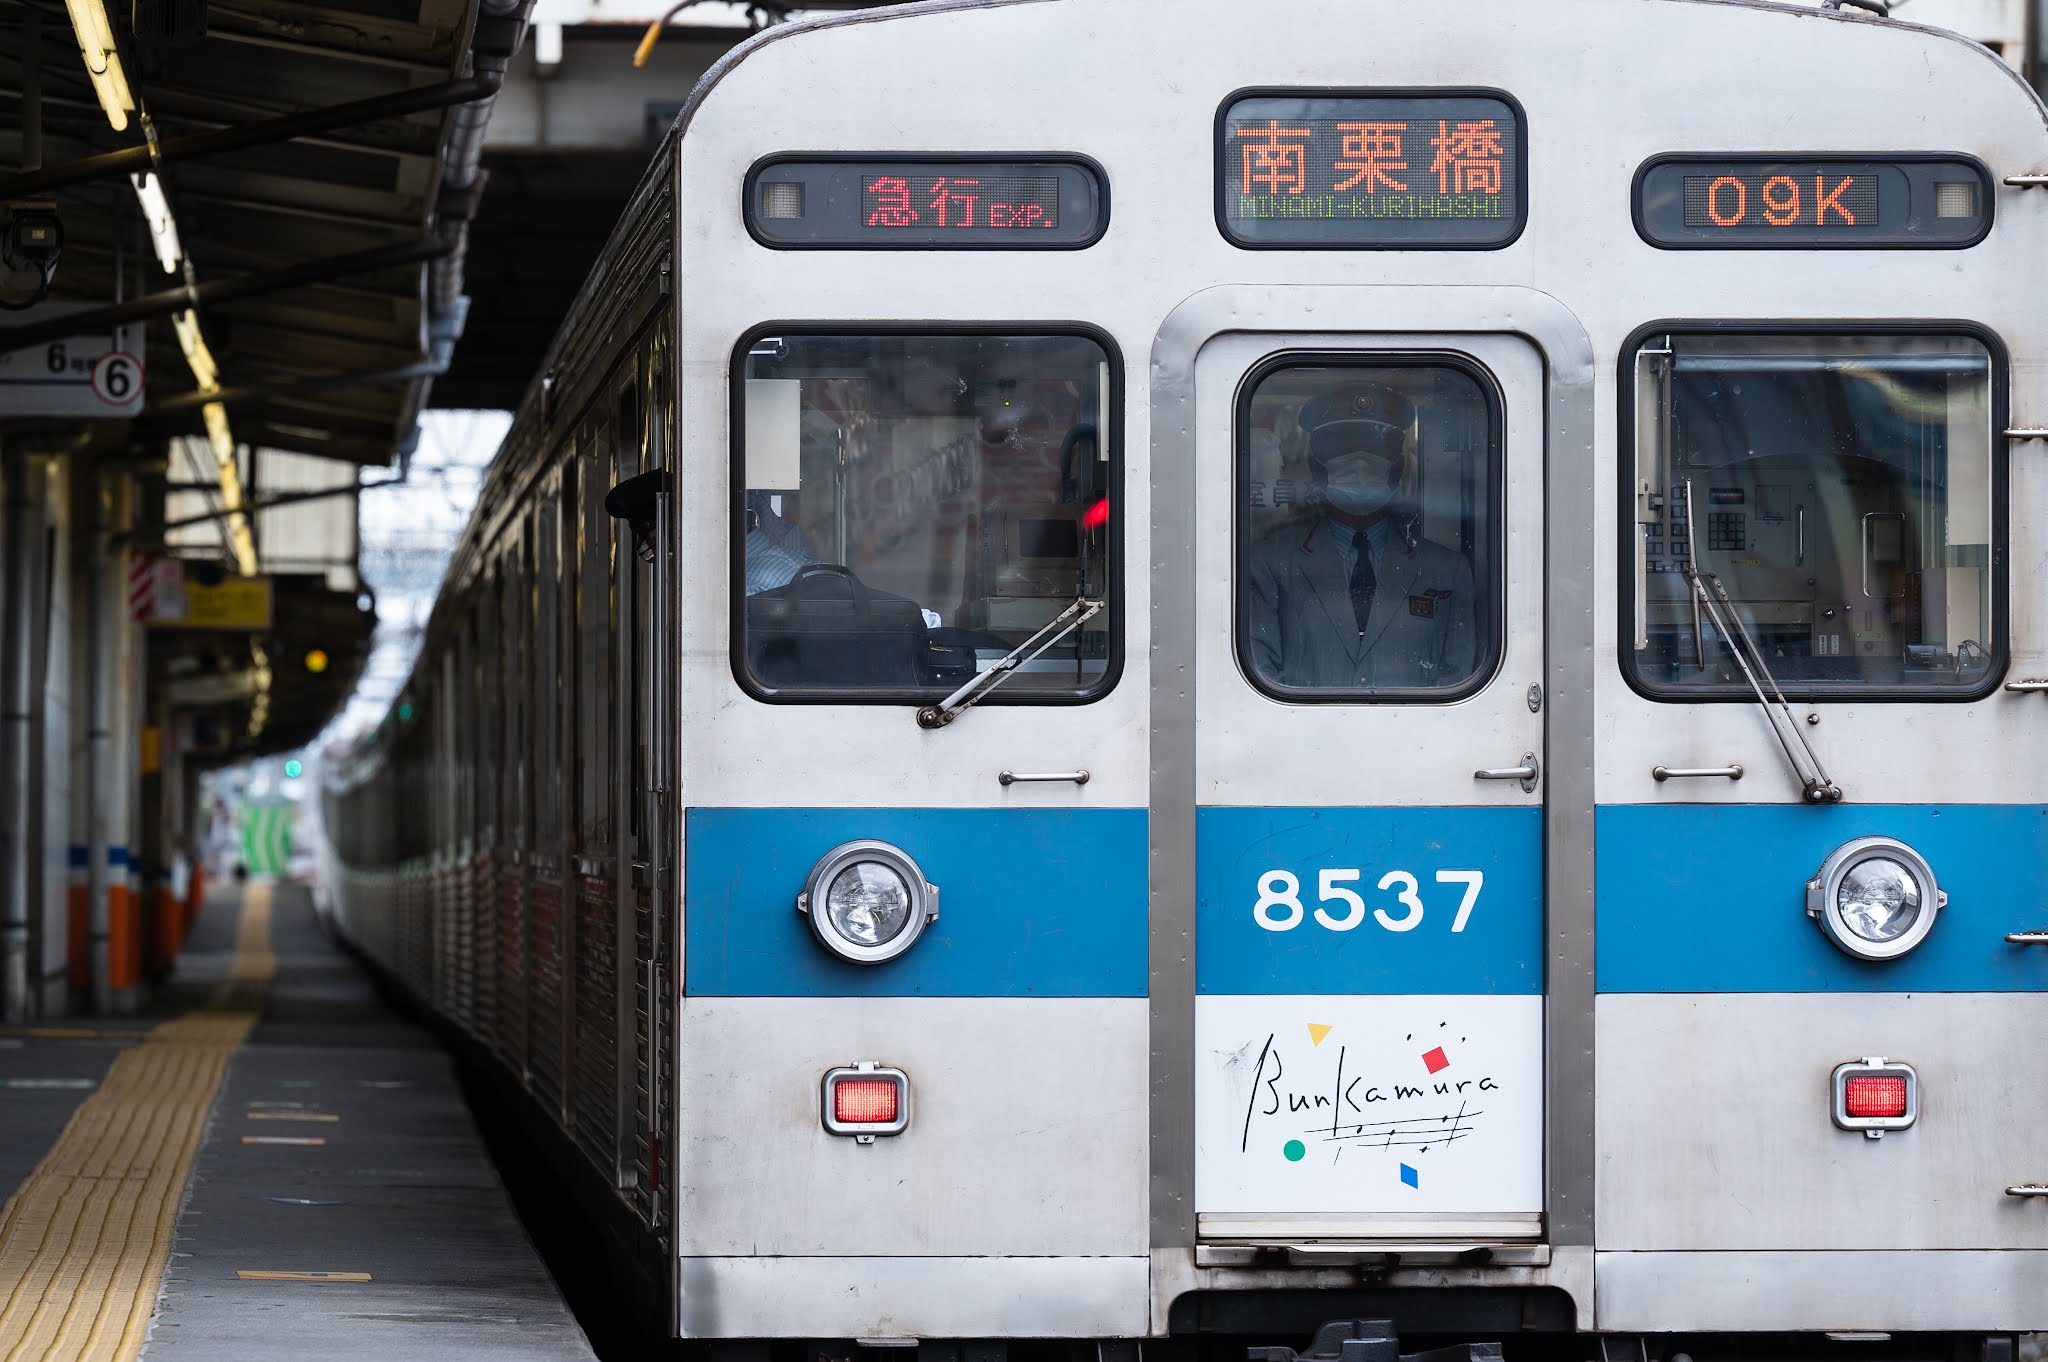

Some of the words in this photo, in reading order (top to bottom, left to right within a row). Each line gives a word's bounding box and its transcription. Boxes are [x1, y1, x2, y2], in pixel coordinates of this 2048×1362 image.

[1236, 119, 1504, 194] 南栗橋
[868, 176, 979, 227] 急行
[989, 203, 1052, 227] EXP.
[1240, 195, 1502, 218] MINAMI-KURIHASHI
[1708, 175, 1854, 226] 09K
[106, 358, 130, 398] 6
[1253, 868, 1484, 933] 8537
[1242, 1032, 1499, 1153] Bunkamura
